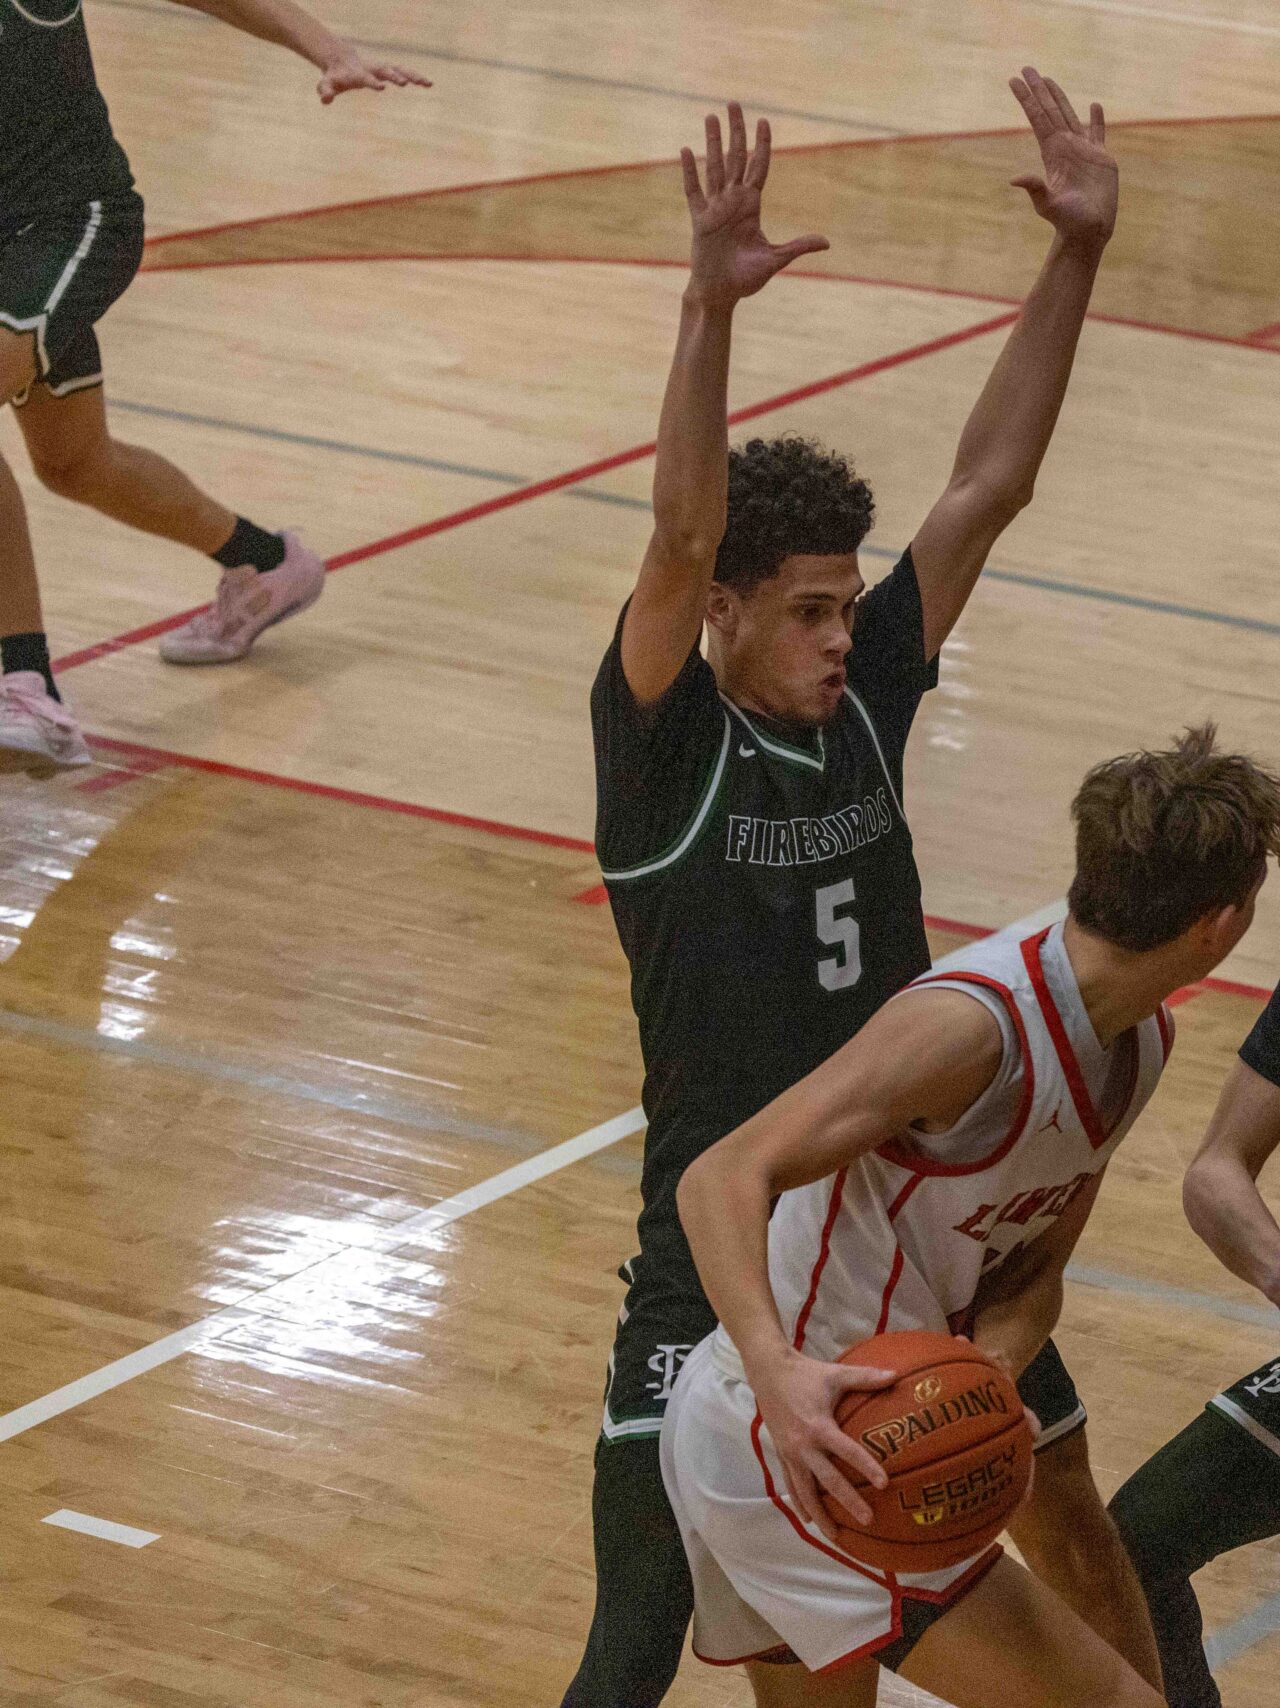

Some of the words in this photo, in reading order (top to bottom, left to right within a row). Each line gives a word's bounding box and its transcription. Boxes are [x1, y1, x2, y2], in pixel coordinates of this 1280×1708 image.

[726, 787, 892, 866] FIREBIRDS
[816, 878, 862, 992] 5
[861, 1382, 1008, 1463] SPALDING
[899, 1444, 1017, 1512] LEGACY
